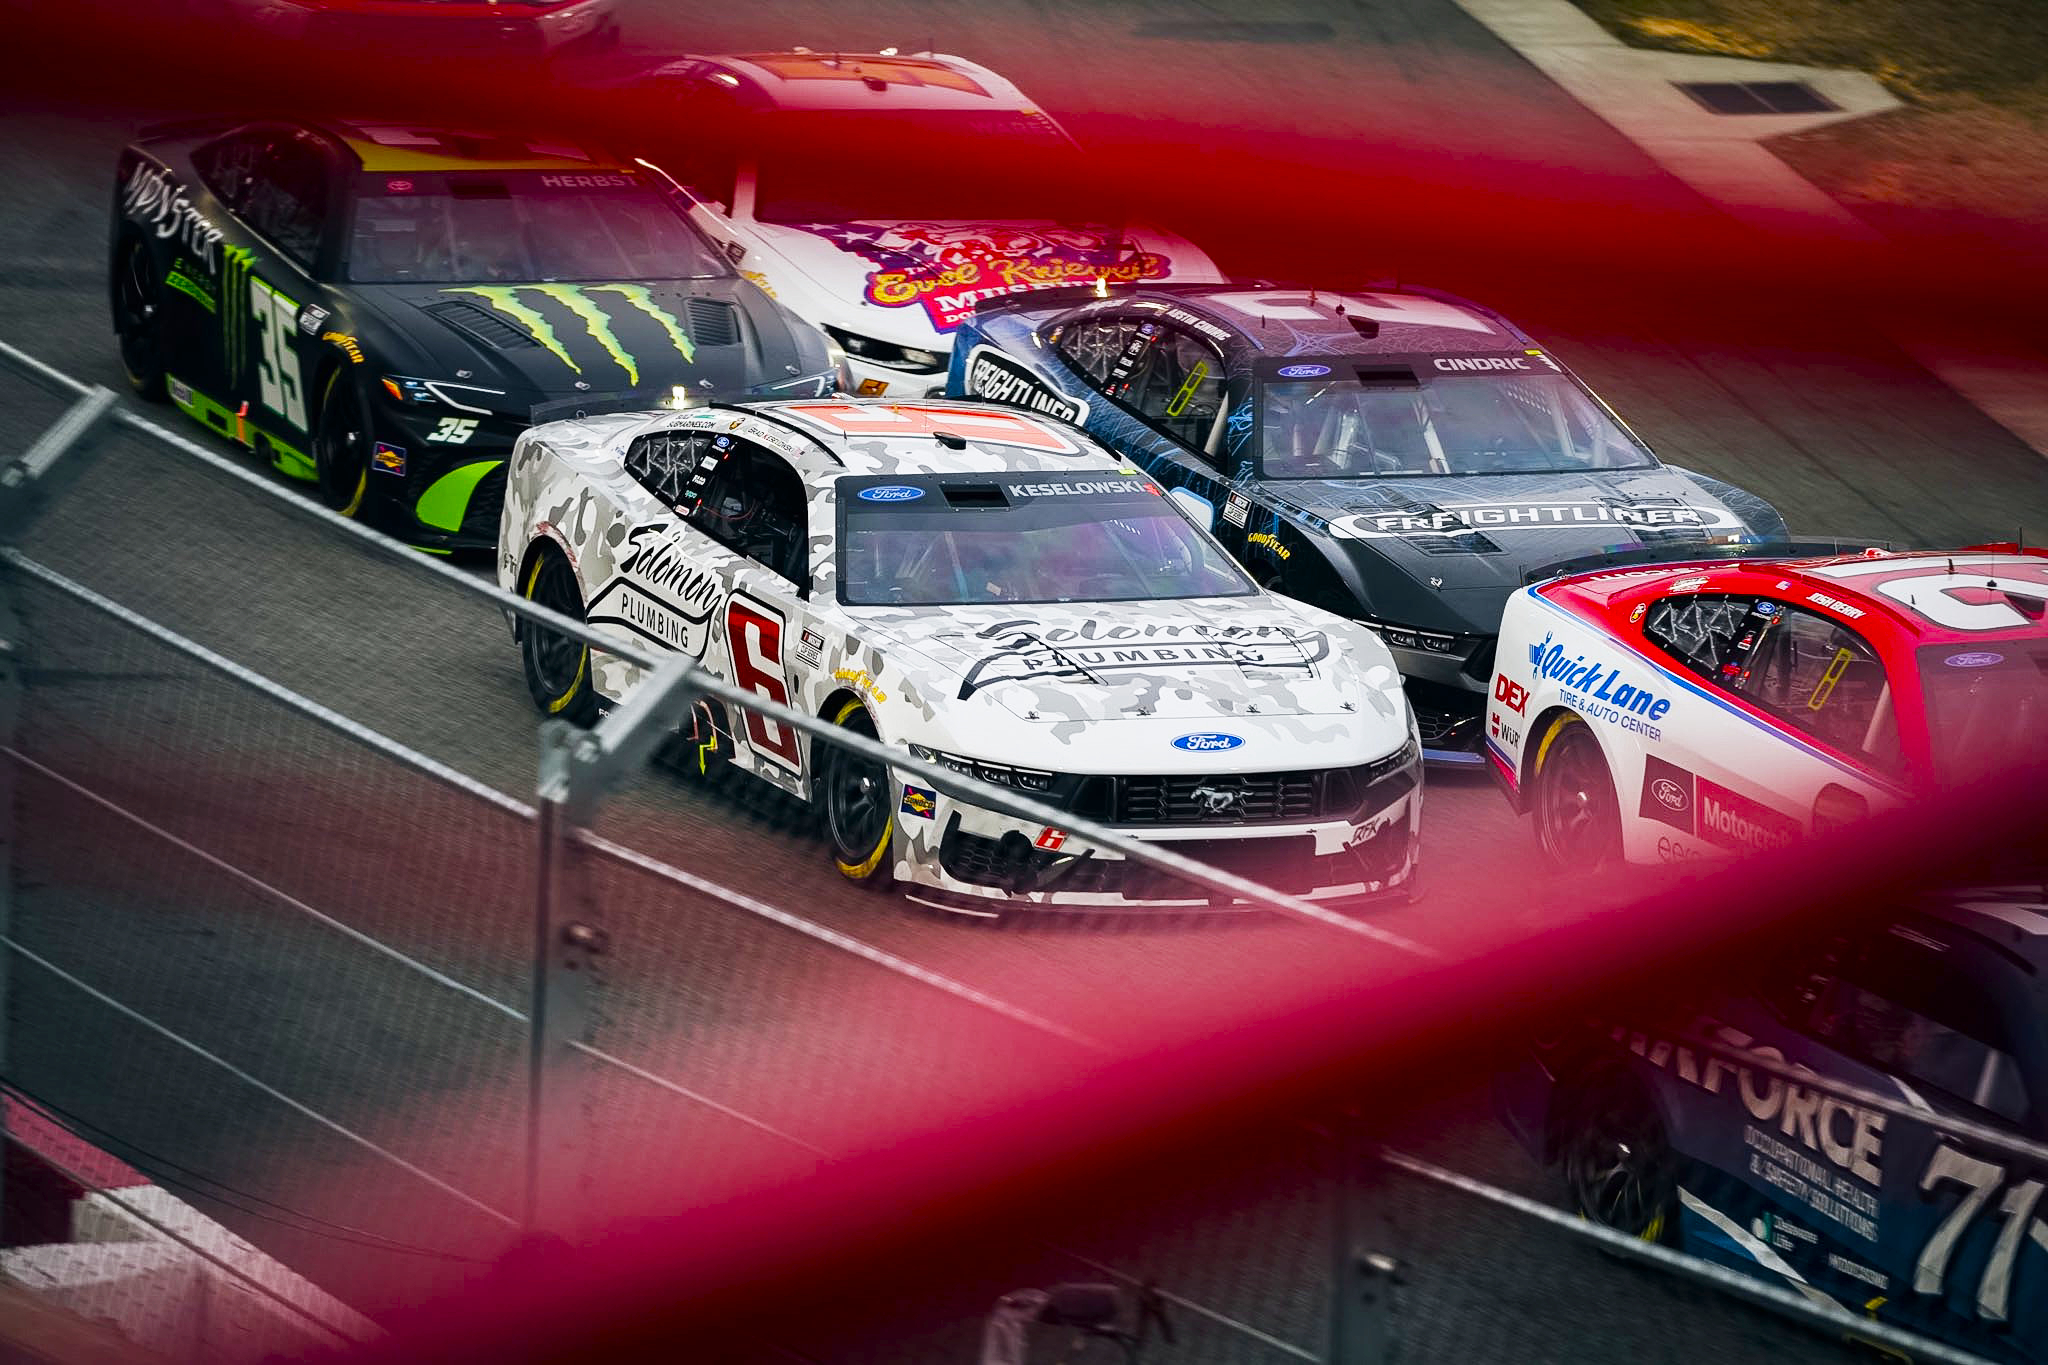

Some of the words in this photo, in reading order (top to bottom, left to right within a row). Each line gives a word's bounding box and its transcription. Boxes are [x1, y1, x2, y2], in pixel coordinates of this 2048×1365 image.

[124, 162, 224, 275] MONSTER
[873, 262, 981, 304] Evel
[250, 273, 307, 435] 35
[1433, 357, 1532, 371] CINDRIC
[427, 416, 479, 444] 35
[1008, 480, 1146, 497] KESELOWSKI
[1374, 507, 1702, 532] FREIGHTLINER
[1247, 532, 1291, 560] GOODYEAR
[620, 523, 722, 611] Solomon
[621, 592, 689, 649] PLUMBING
[1806, 592, 1833, 608] JOSH
[1829, 599, 1867, 620] BERRY
[976, 619, 1312, 650] Solomon
[1023, 646, 1265, 670] PLUMBING
[727, 600, 801, 768] 6
[1494, 672, 1530, 720] DEX
[1541, 643, 1605, 693] Quick
[1593, 669, 1672, 722] Lane
[1559, 688, 1579, 709] TIRE
[1578, 698, 1586, 712] &
[1586, 702, 1620, 725] AUTO
[1620, 715, 1662, 743] CENTER
[1185, 733, 1233, 750] Ford
[1501, 721, 1522, 751] WÜR
[904, 794, 934, 810] SUNOCO
[1034, 826, 1068, 851] 6
[1912, 1144, 2046, 1322] 71
